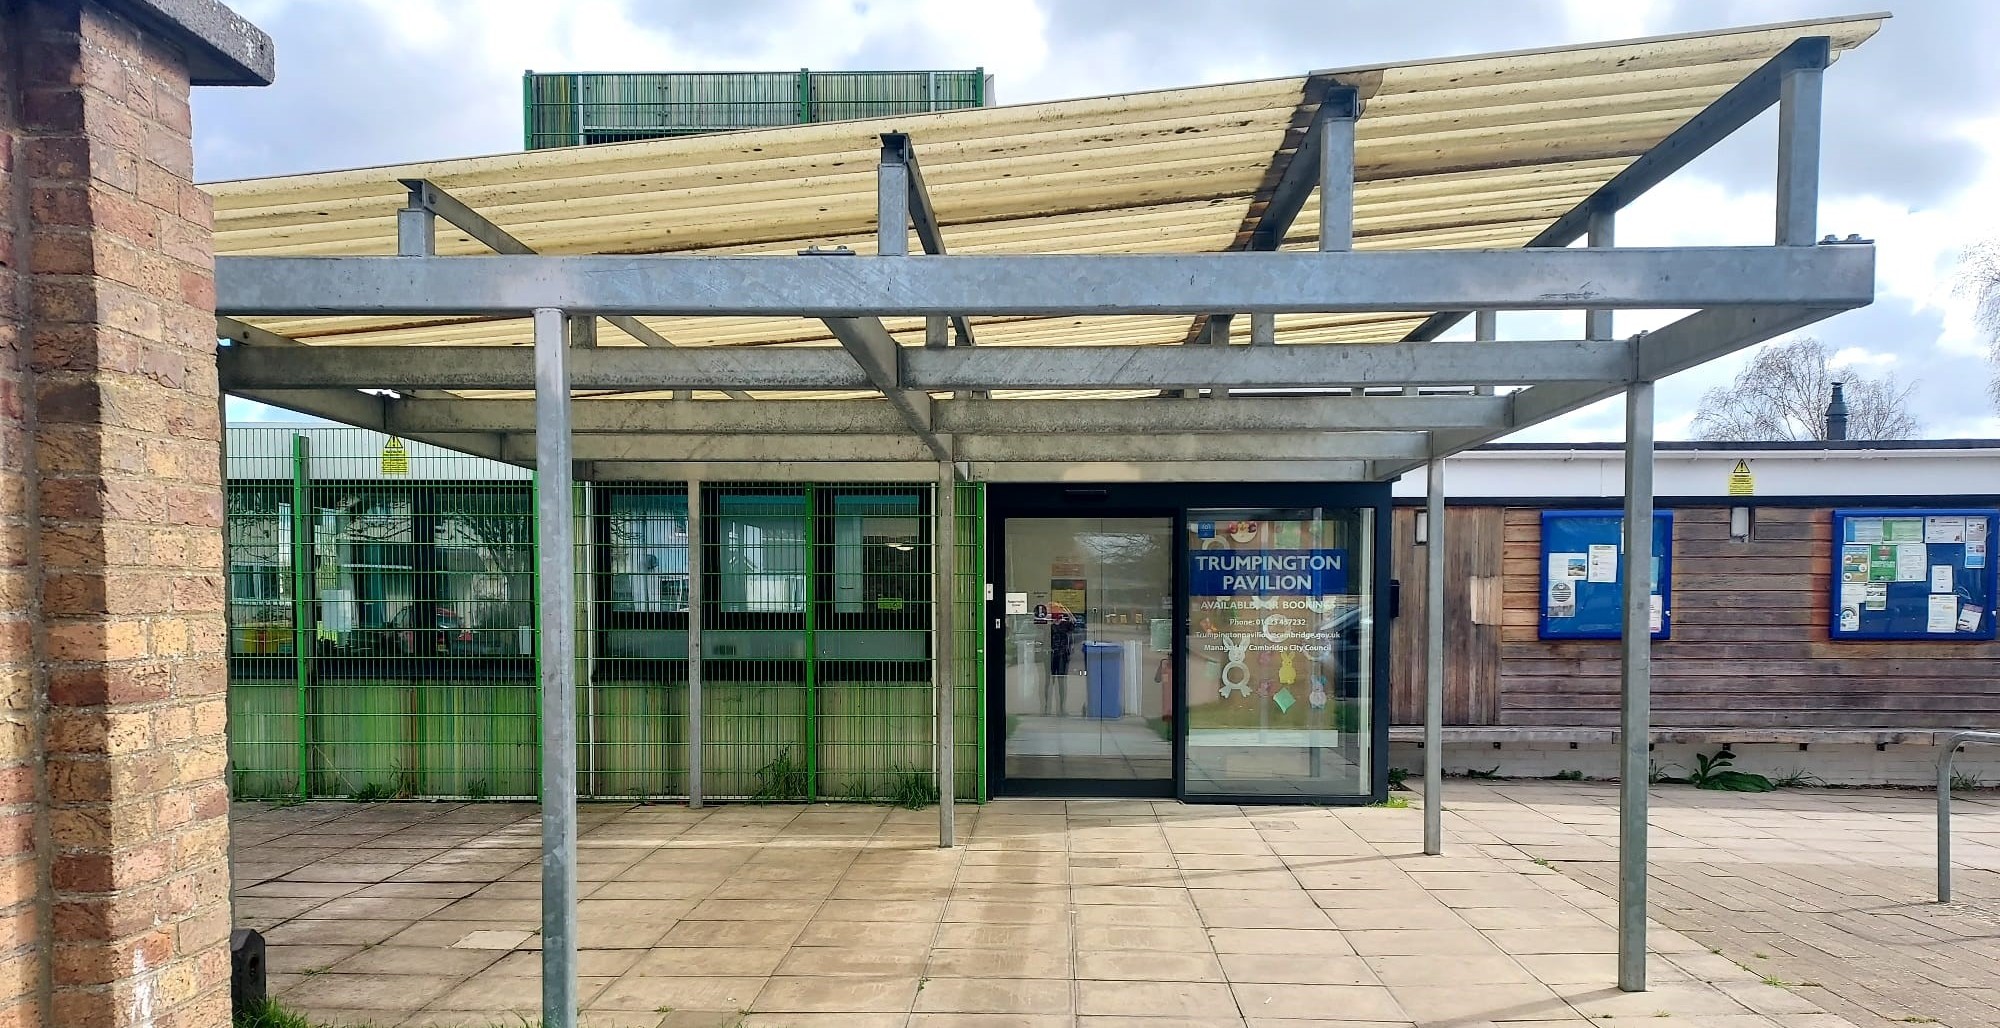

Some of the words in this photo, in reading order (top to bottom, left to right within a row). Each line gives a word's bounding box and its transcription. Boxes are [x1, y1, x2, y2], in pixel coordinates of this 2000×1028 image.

[1195, 555, 1341, 571] TRUMPINGTON
[1223, 575, 1312, 590] PAVILION
[1201, 601, 1256, 610] AVAILABLE
[1260, 601, 1278, 610] OR
[1282, 600, 1336, 609] BOOKIN
[1229, 618, 1255, 626] Phone:
[1256, 618, 1278, 626] 0123
[1279, 618, 1306, 626] 457232
[1195, 631, 1341, 640] Trumpintonpaviliocambridge.gov.uk
[1248, 644, 1288, 653] Cambridge
[1289, 644, 1304, 653] City
[1304, 644, 1332, 652] Council
